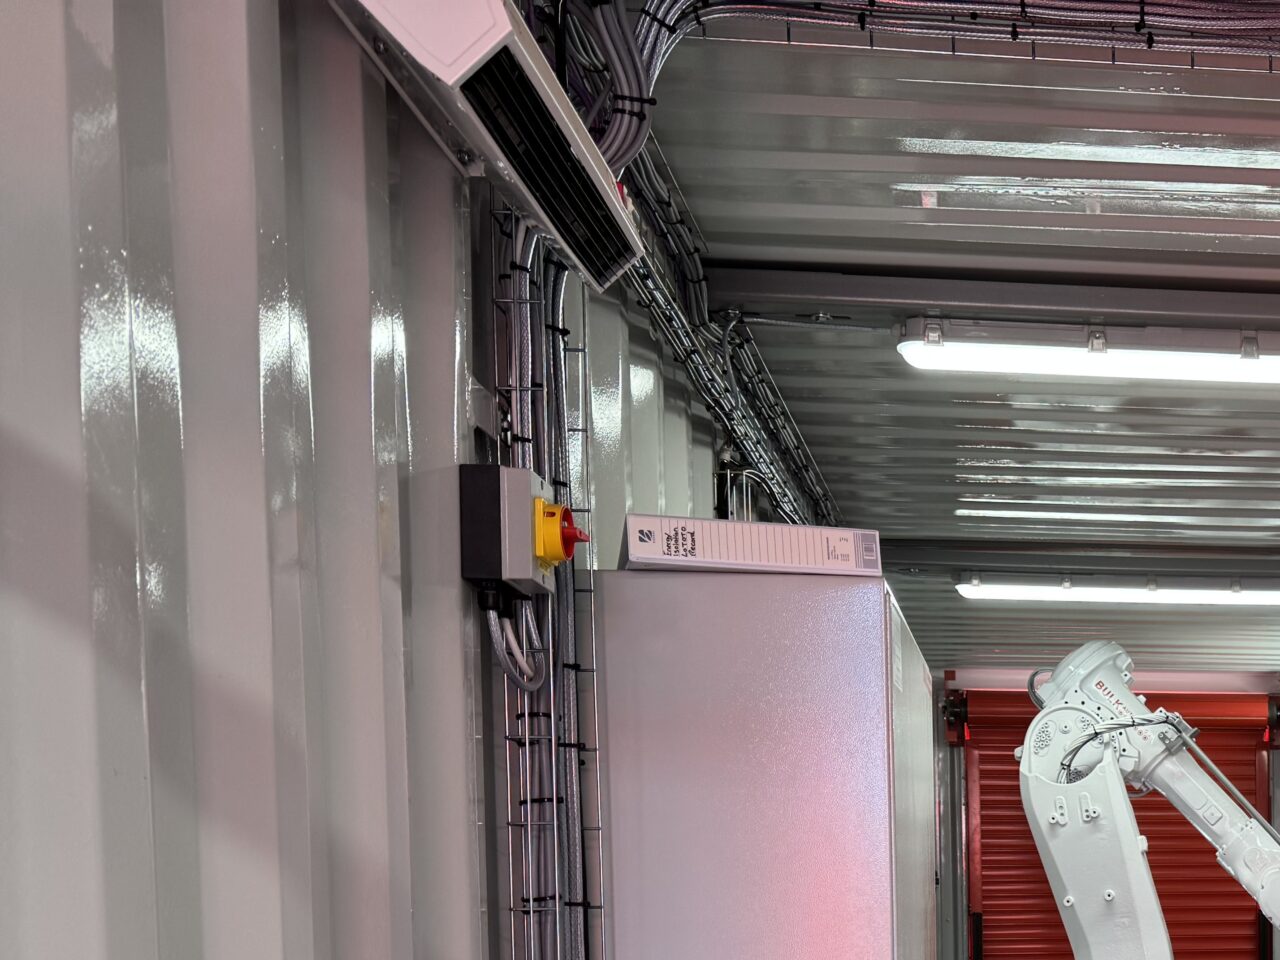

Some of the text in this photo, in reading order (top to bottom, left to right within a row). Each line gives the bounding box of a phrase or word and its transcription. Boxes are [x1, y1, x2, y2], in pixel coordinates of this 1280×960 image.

[662, 532, 673, 556] Energy
[687, 530, 697, 557] Record
[1095, 680, 1123, 706] BULK
